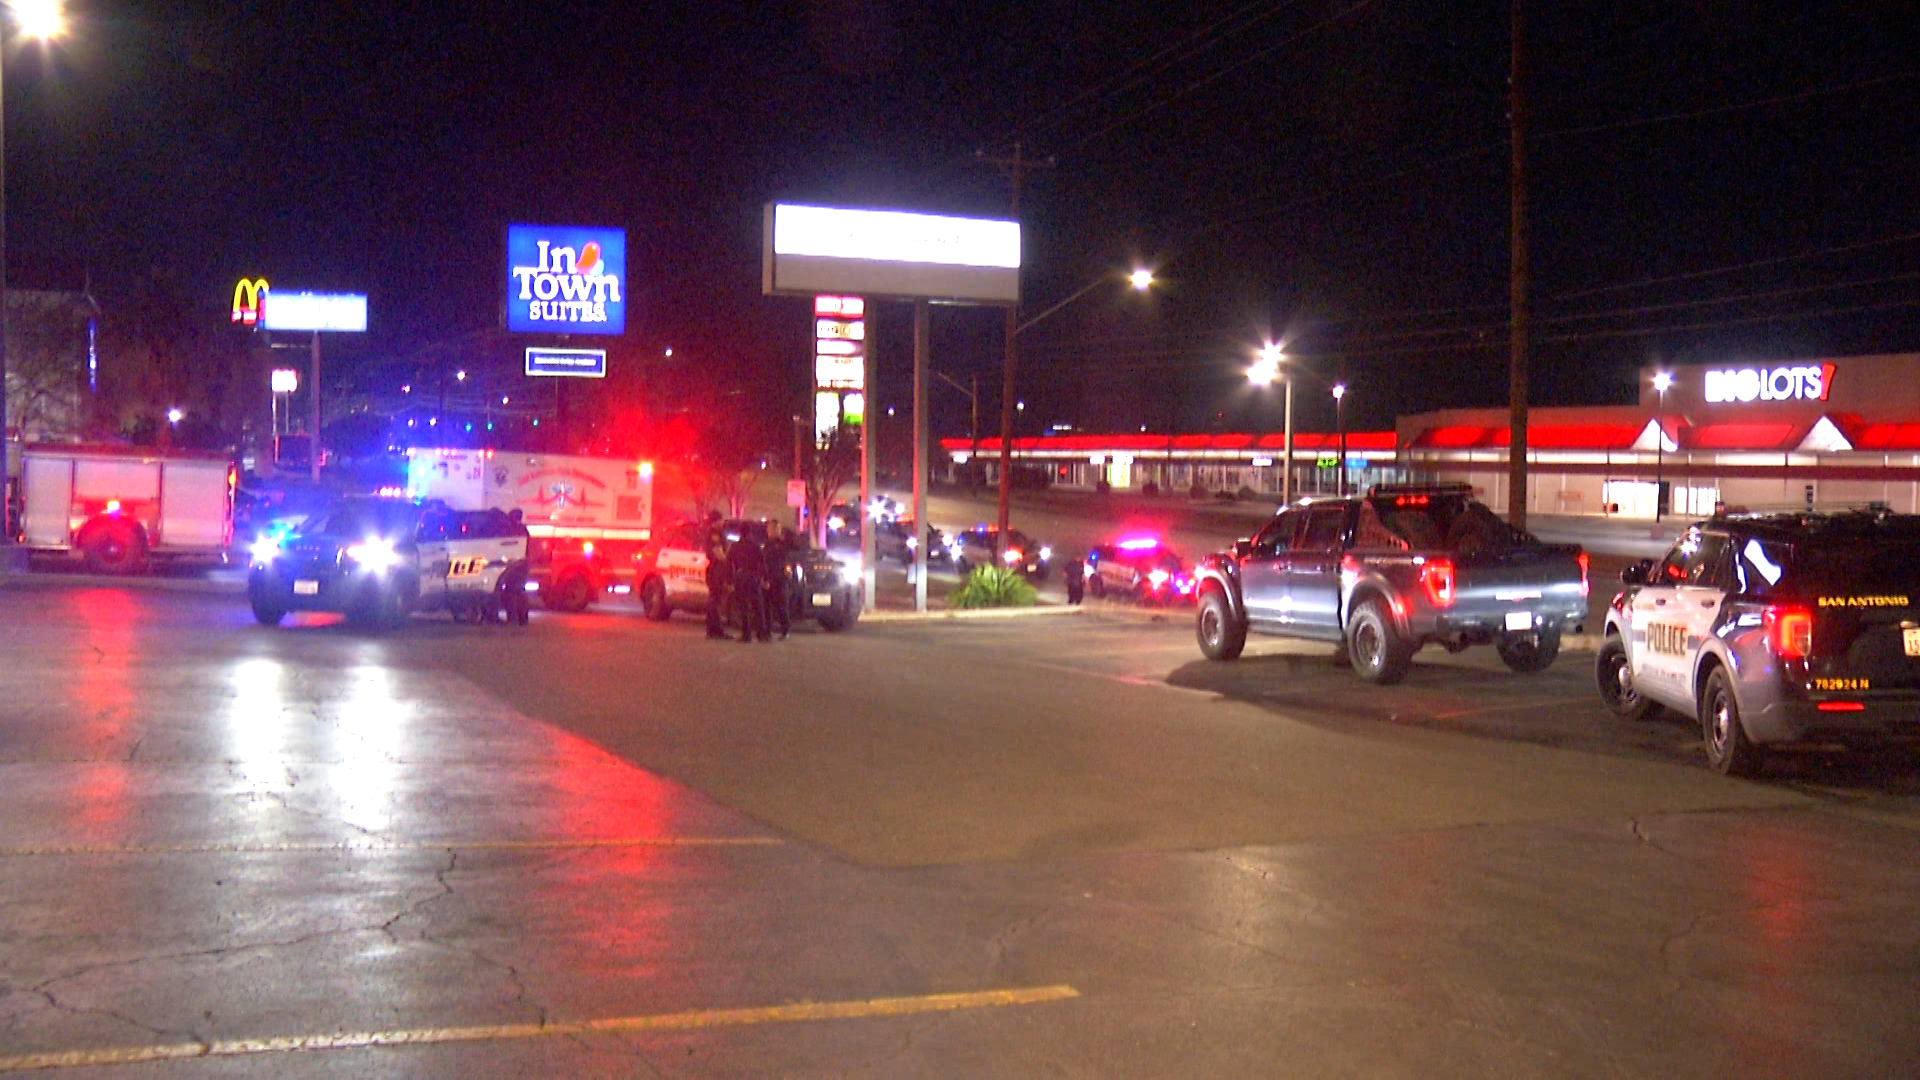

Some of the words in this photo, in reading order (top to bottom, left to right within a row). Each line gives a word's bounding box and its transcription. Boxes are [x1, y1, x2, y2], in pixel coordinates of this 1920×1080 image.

[537, 240, 577, 274] In
[512, 265, 621, 303] Town
[529, 300, 608, 323] SUITES
[1818, 596, 1846, 607] SAN
[1846, 595, 1909, 607] ANTONIO
[1647, 621, 1687, 656] POLICE
